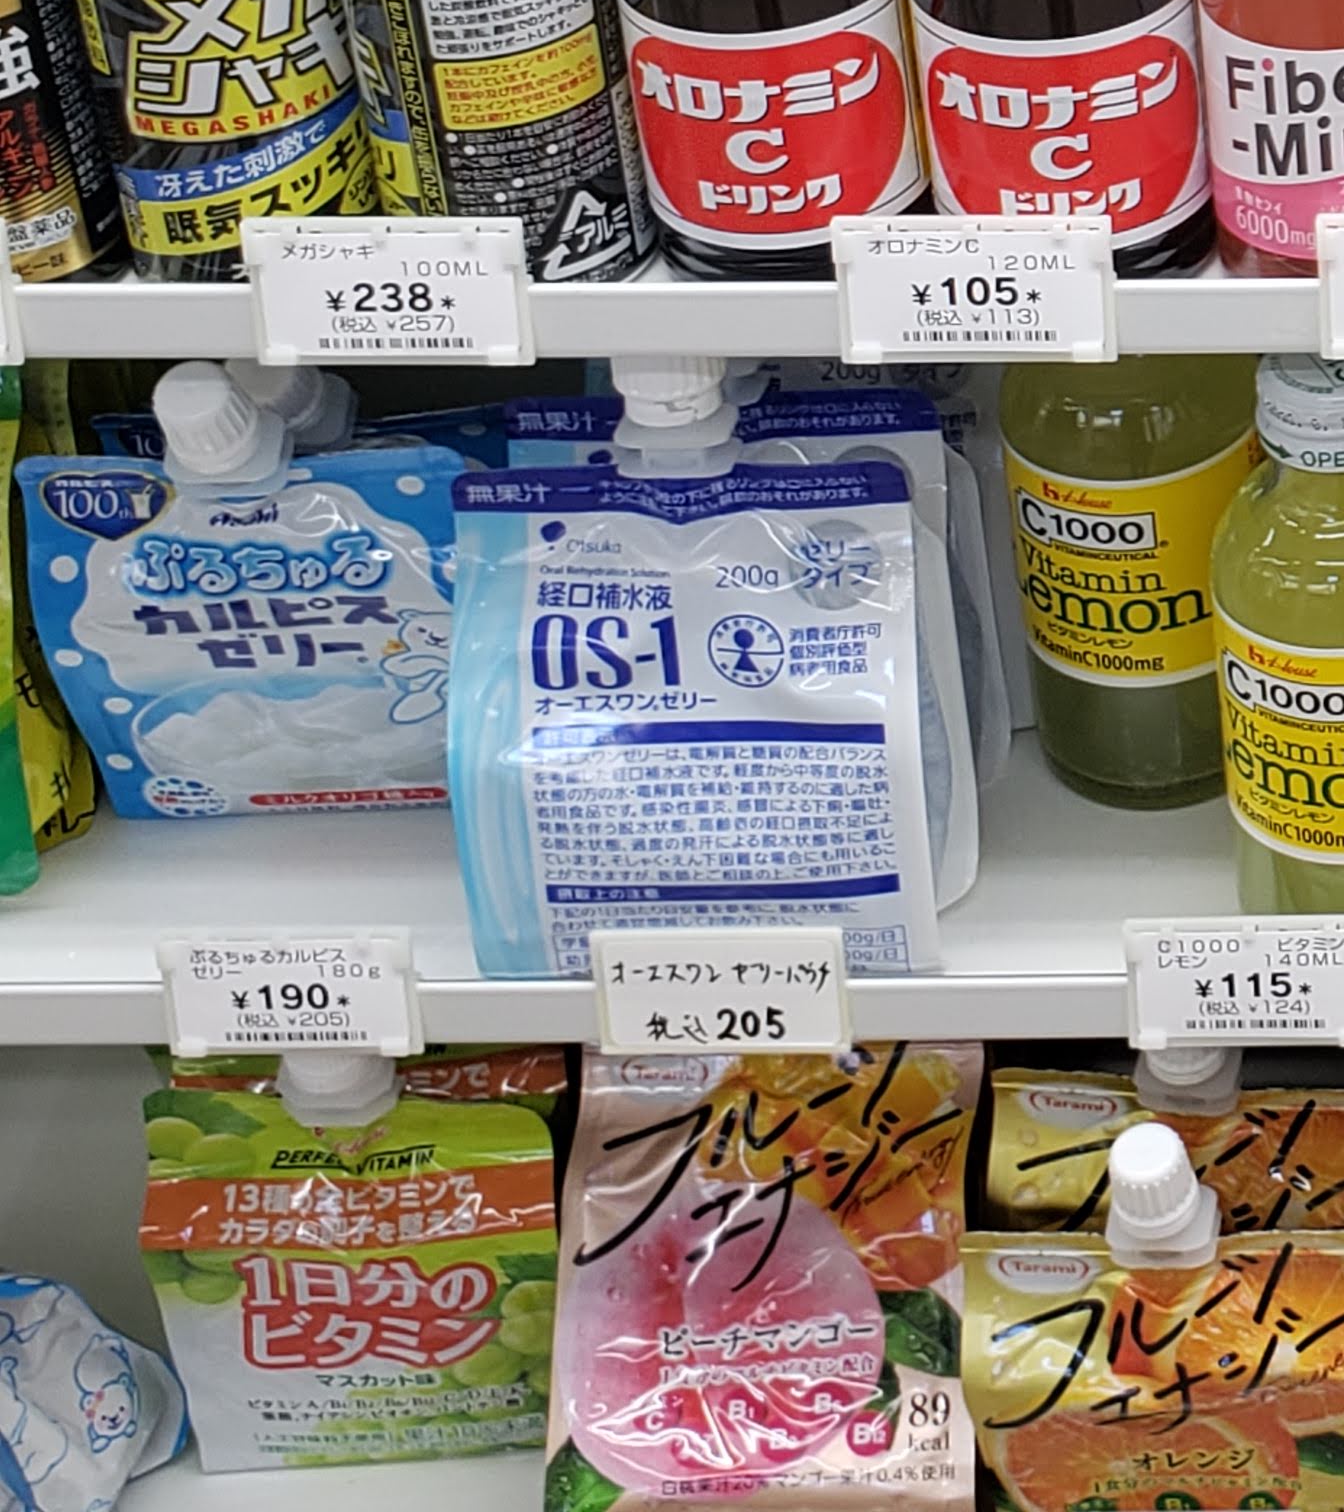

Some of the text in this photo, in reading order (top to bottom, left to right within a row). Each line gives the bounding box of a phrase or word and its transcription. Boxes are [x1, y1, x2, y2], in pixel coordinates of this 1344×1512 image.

[137, 85, 336, 135] MEGASHAKI
[937, 55, 1178, 130] オロナミン
[155, 121, 326, 197] 冴えた刺激で
[725, 128, 789, 175] C
[1030, 134, 1093, 180] C
[699, 173, 842, 213] ドリンク
[283, 242, 374, 260] メガシャキ
[868, 238, 980, 254] オロナミンC
[988, 253, 1075, 270] 120ML
[387, 314, 454, 333] ¥257)
[1019, 499, 1145, 544] C1000
[129, 536, 391, 595] ぷるちゅる
[716, 565, 779, 589] 200g
[135, 597, 398, 635] カルピス
[538, 580, 673, 610] 経口補水液
[532, 616, 679, 690] OS-1
[716, 1009, 785, 1040] 205
[242, 1256, 489, 1309] 1日分の
[249, 1314, 495, 1368] ビタミン
[909, 1391, 950, 1425] 89
